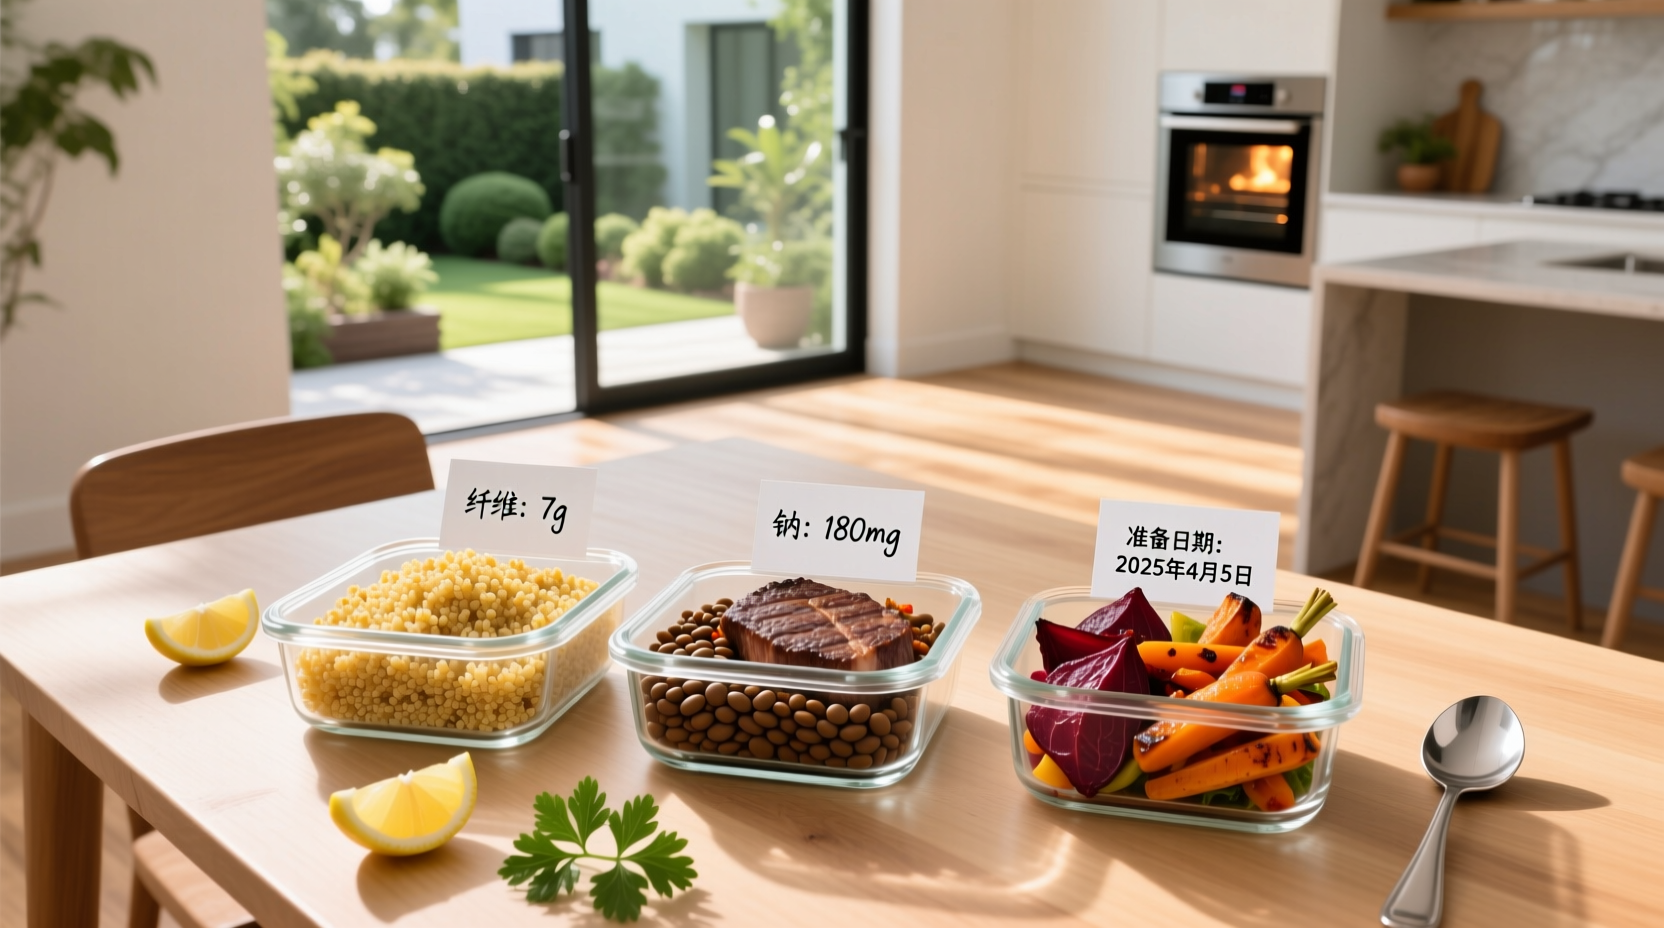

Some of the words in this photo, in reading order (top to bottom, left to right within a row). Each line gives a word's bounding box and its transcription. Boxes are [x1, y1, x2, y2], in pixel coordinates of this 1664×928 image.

[464, 487, 527, 521] 纤维：
[541, 496, 568, 535] 7g
[772, 508, 810, 541] 钠：
[825, 514, 902, 558] 180mg
[1126, 525, 1222, 554] 准备日期：
[1115, 555, 1253, 587] 2025年4月5日
